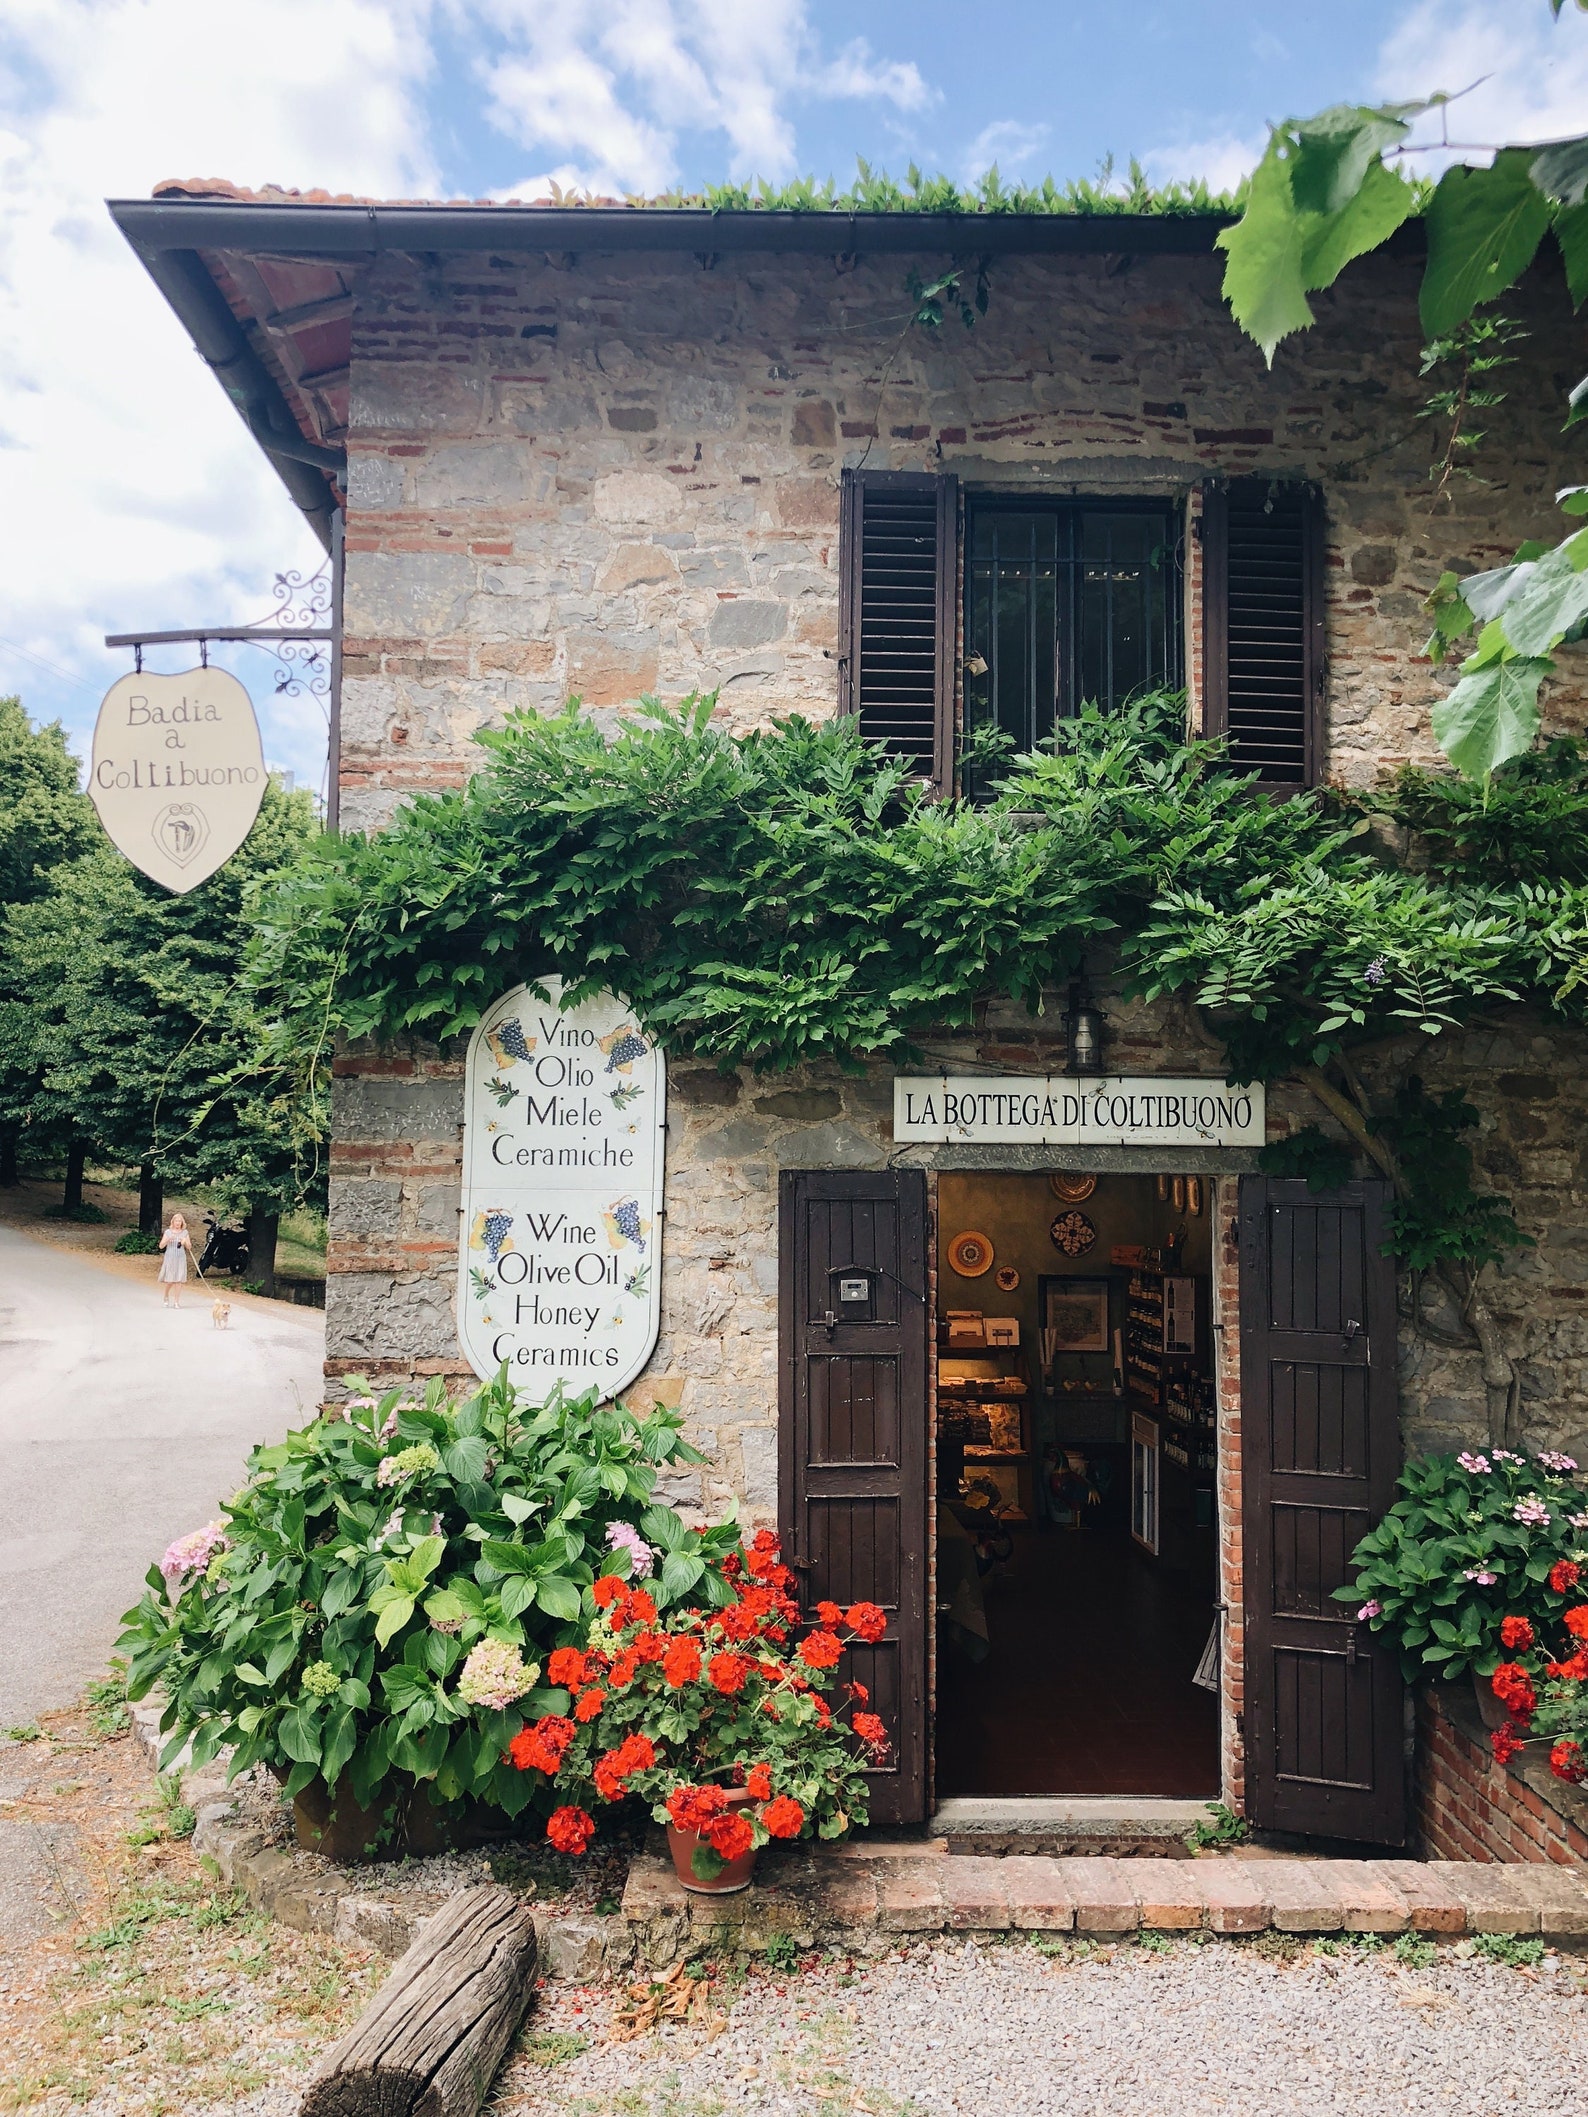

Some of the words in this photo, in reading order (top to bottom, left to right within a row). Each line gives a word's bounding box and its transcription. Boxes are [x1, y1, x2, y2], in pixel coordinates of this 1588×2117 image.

[127, 695, 222, 726] Badia
[165, 729, 185, 748] a
[97, 759, 259, 789] Coltibuono
[539, 1017, 595, 1047] Vino
[535, 1055, 594, 1087] Olio
[526, 1096, 602, 1126] Miele
[905, 1093, 938, 1125] LA
[943, 1093, 1058, 1126] BOTTEGA
[1062, 1094, 1088, 1126] DI
[1094, 1095, 1252, 1128] COLTIBUONO
[491, 1133, 634, 1167] Ceramiche
[526, 1213, 596, 1244] Wine
[497, 1252, 571, 1284] Olive
[574, 1253, 619, 1285] Oil
[514, 1294, 600, 1332] Honey
[492, 1333, 619, 1366] Ceramics
